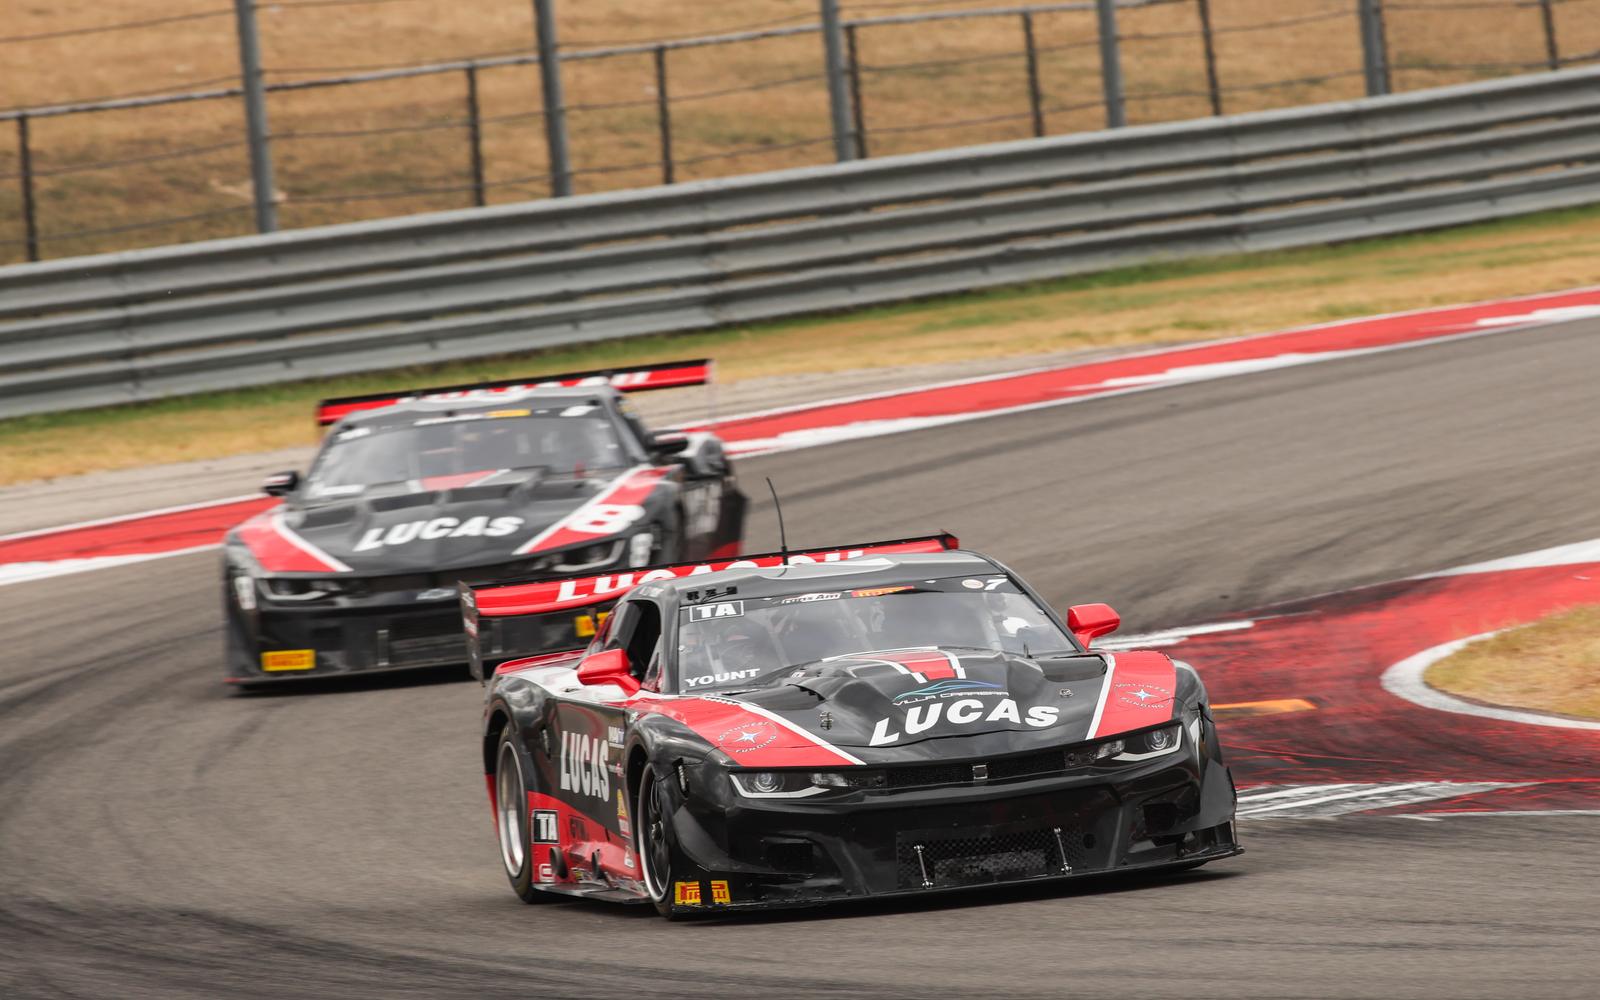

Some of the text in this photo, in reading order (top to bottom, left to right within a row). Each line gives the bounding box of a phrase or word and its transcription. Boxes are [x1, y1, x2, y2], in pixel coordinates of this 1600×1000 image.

[353, 516, 525, 552] LUCAS
[983, 578, 1009, 591] 7
[696, 603, 737, 619] TA
[685, 668, 760, 687] YOUNT
[869, 698, 1060, 746] LUCAS
[560, 730, 610, 802] LUCAS
[536, 813, 557, 841] TA
